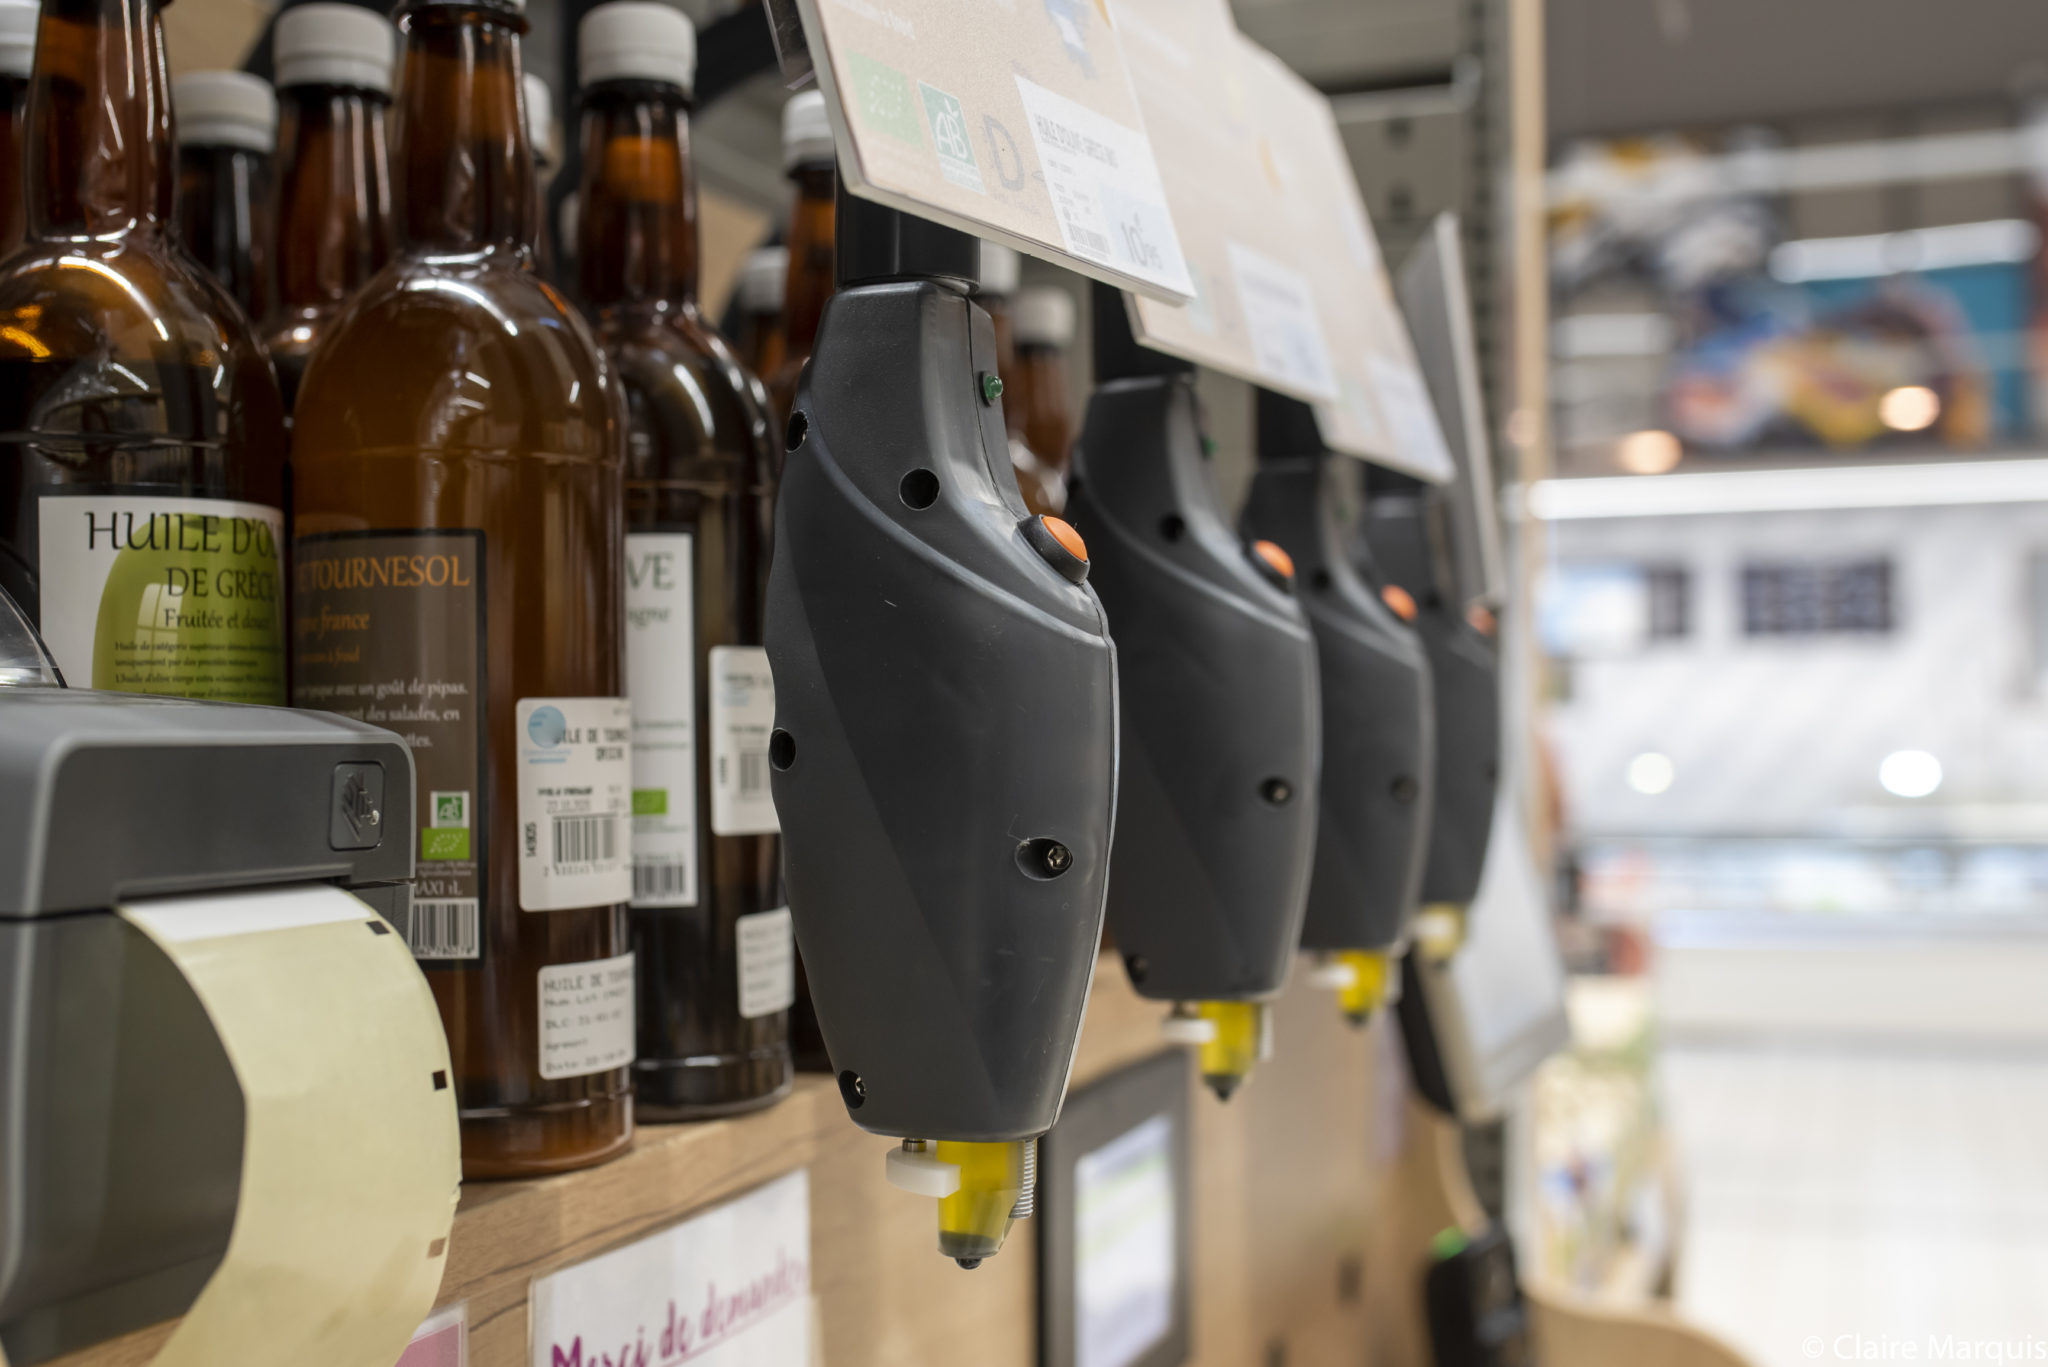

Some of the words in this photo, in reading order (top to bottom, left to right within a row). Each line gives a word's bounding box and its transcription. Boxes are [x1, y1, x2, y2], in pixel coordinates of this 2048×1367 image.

[84, 511, 221, 552] HUILE
[165, 566, 209, 597] DE
[311, 555, 470, 590] TOURNESOL
[164, 607, 223, 629] Fruitée
[376, 678, 404, 700] goût
[407, 677, 425, 695] de
[427, 681, 468, 699] pipas.
[443, 709, 460, 721] en
